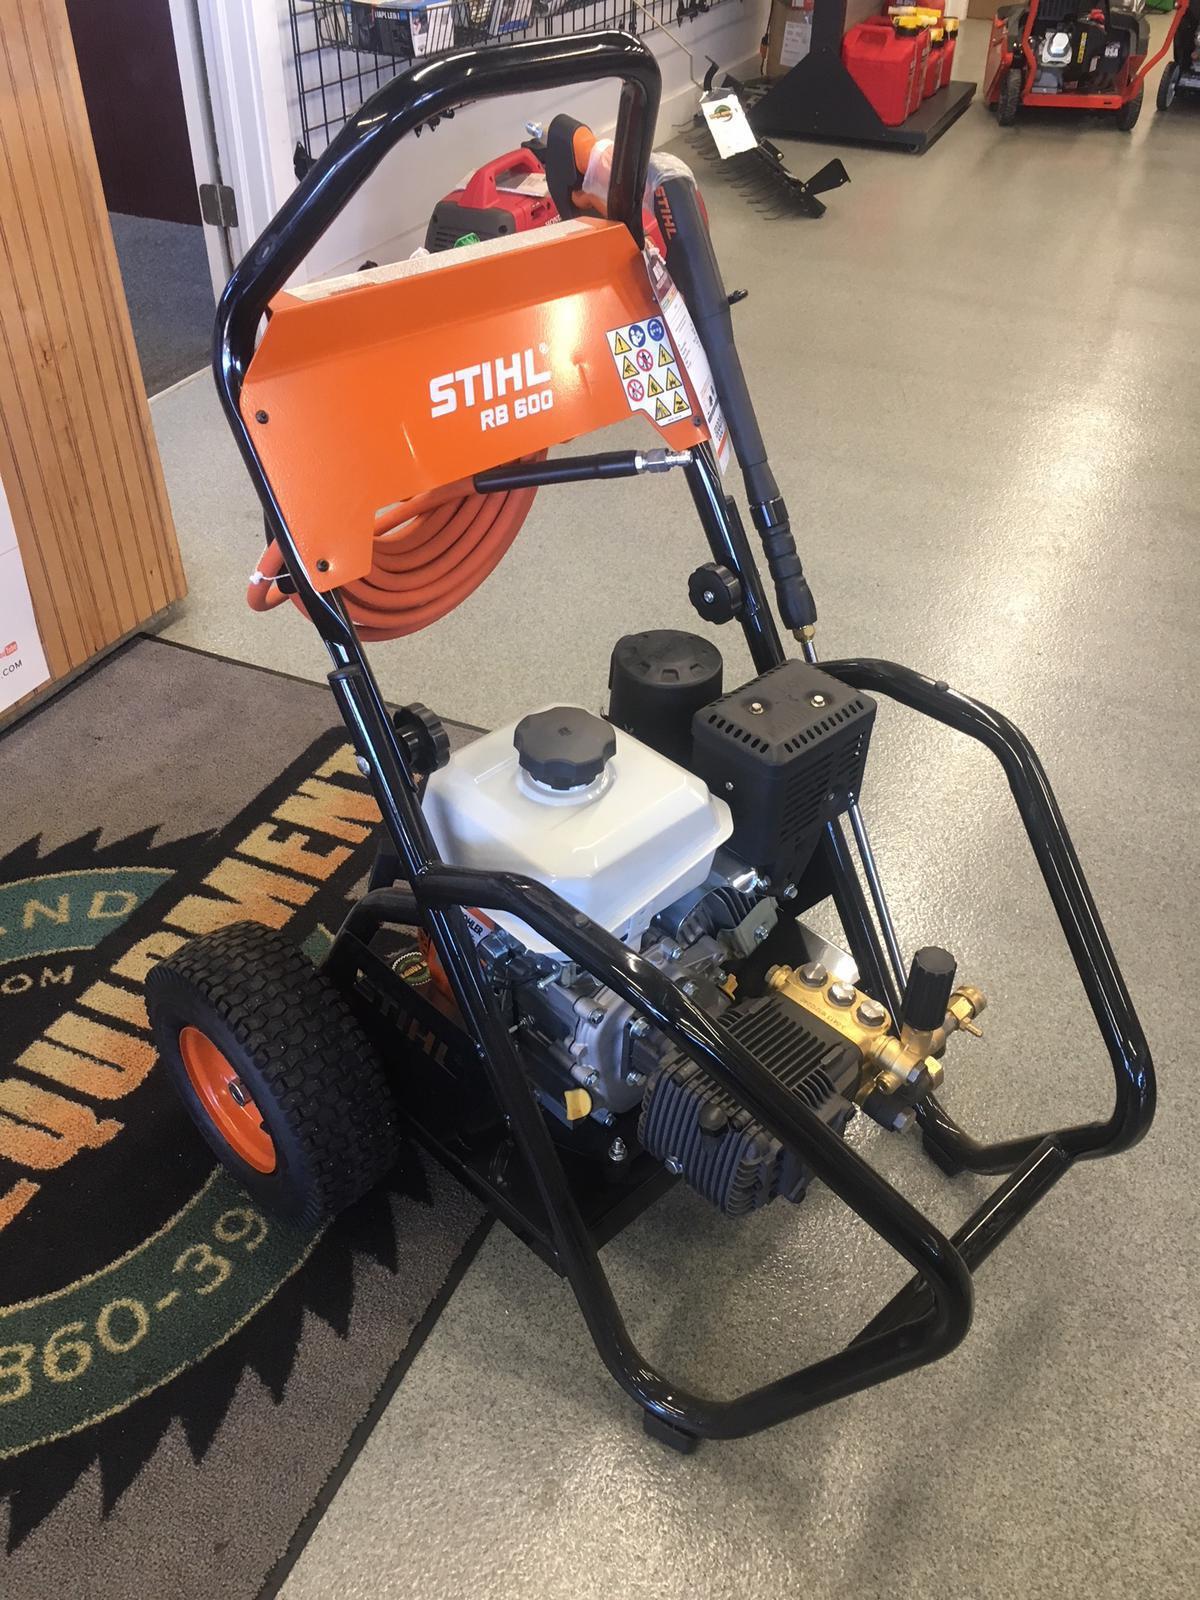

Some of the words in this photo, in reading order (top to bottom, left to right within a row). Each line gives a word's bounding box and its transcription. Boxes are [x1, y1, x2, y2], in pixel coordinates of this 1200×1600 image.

[655, 185, 677, 241] STIHL
[429, 348, 552, 419] STIHL
[480, 403, 509, 431] RB
[514, 389, 554, 419] 600
